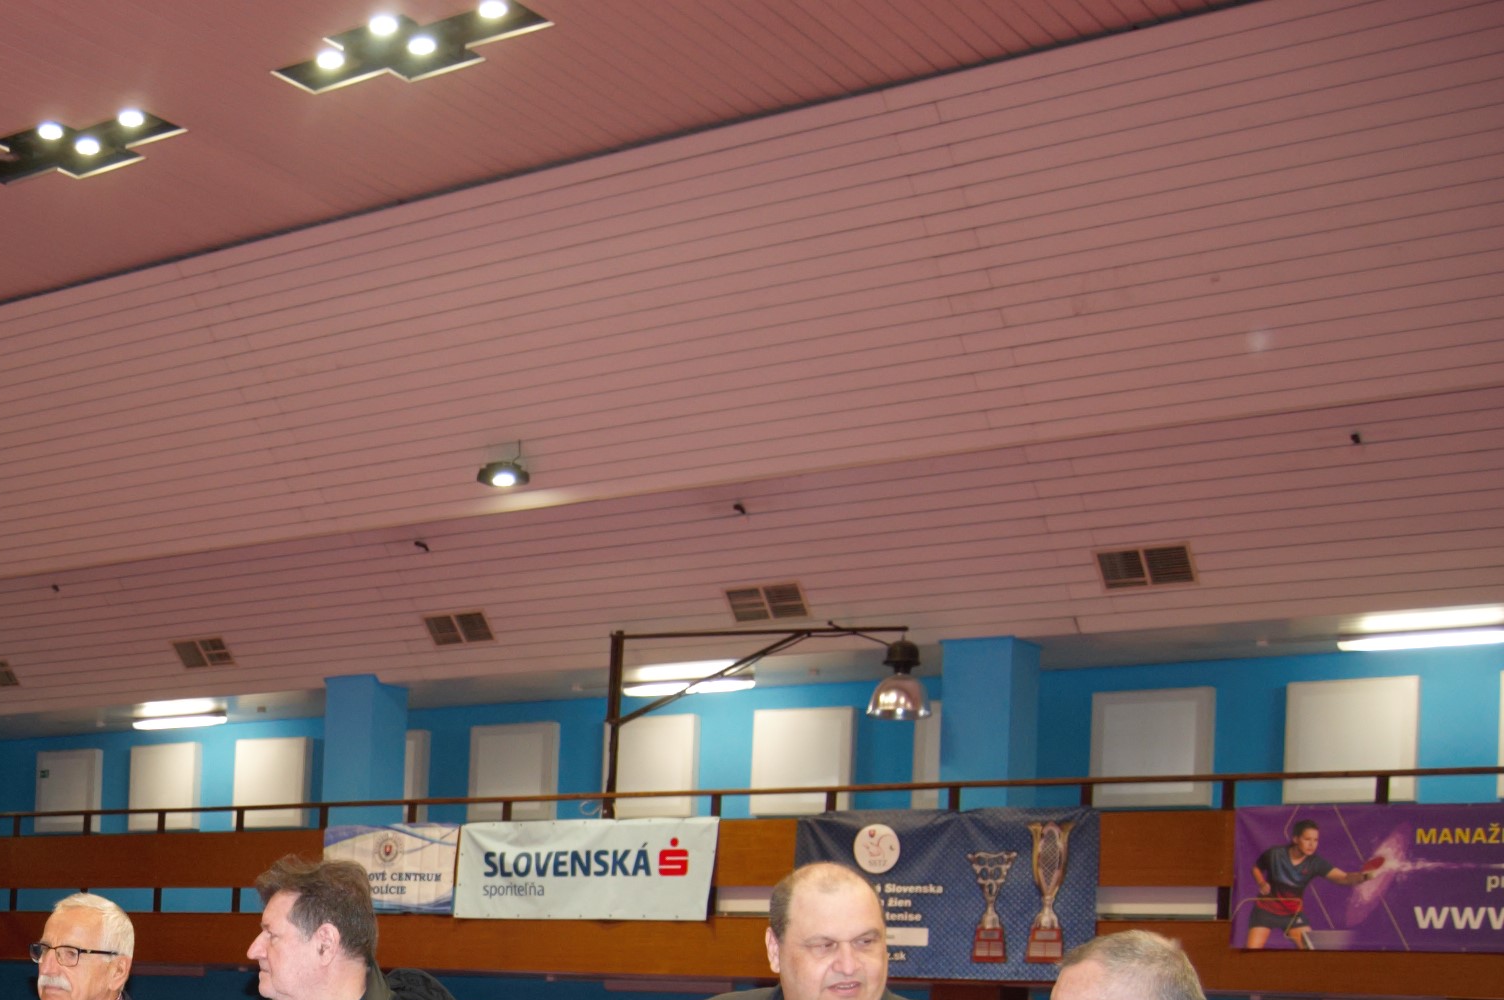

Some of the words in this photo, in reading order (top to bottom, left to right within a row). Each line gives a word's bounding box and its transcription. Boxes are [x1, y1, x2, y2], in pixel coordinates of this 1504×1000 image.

[1416, 823, 1504, 844] MANAŽ
[483, 842, 651, 877] SLOVENSKÁ
[390, 872, 442, 882] CENTRUM
[482, 882, 545, 897] sporiteľňa
[884, 883, 943, 893] Slovenska
[887, 898, 912, 907] žien
[885, 912, 922, 922] tenise
